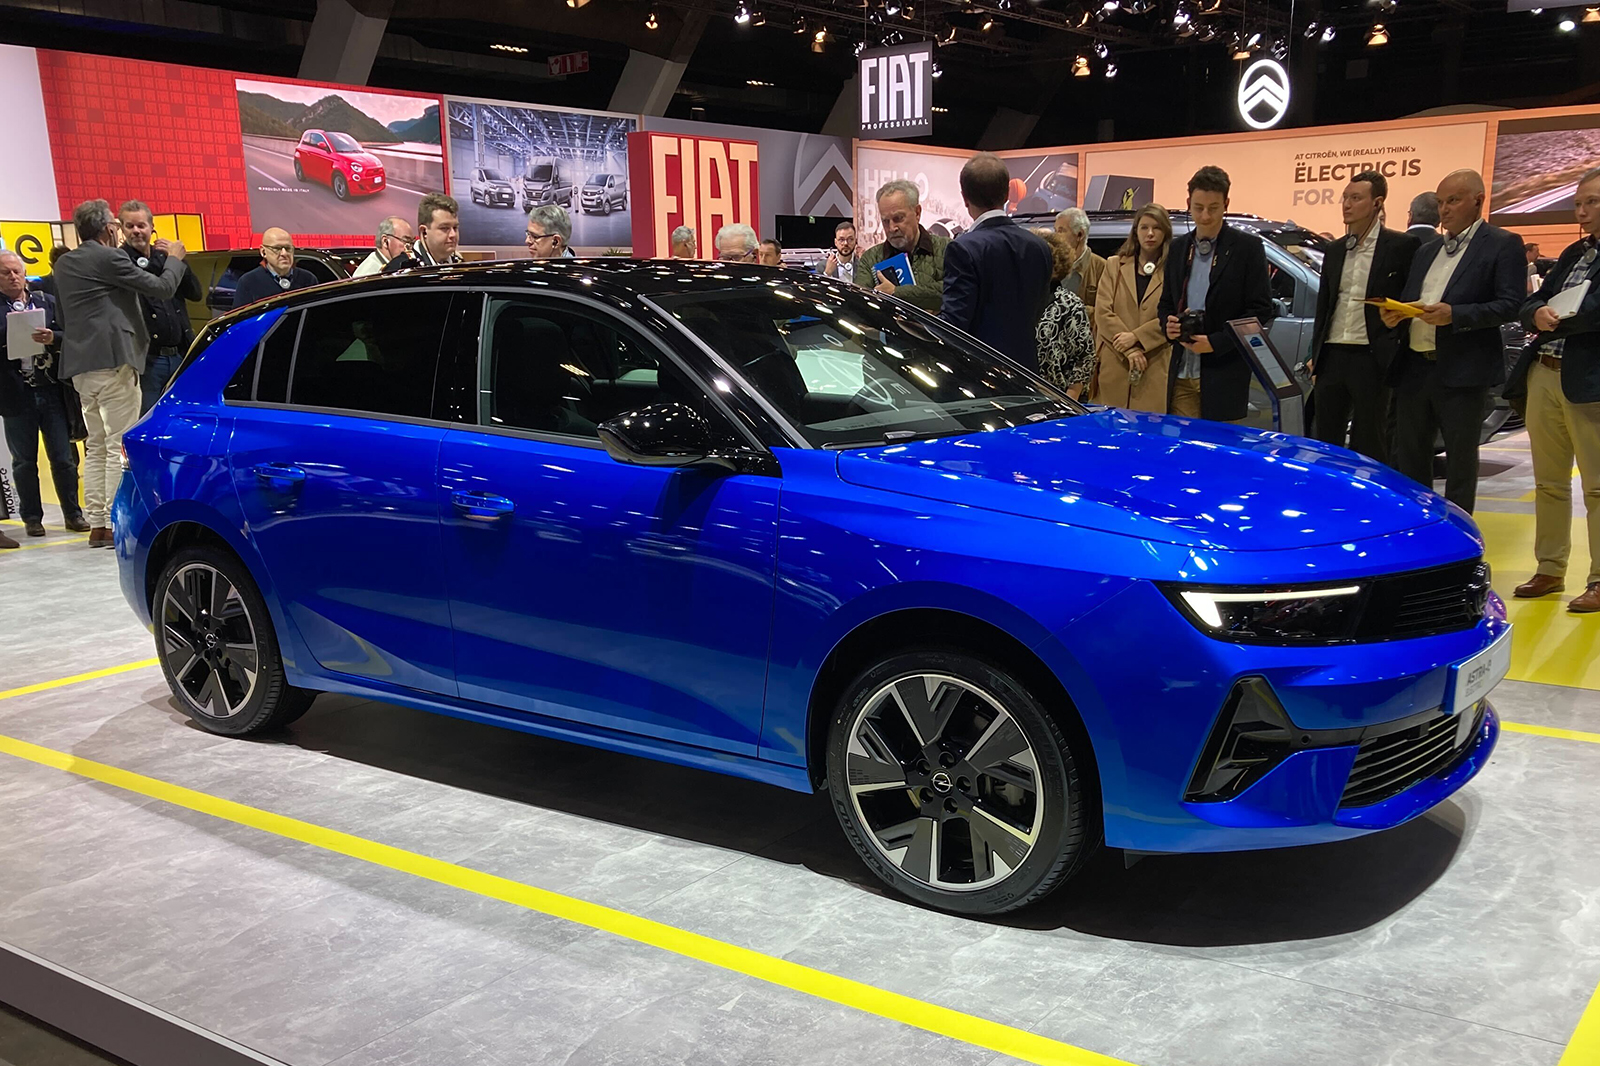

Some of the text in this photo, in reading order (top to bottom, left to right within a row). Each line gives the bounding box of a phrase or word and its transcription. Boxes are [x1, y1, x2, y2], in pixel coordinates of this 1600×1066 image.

[861, 52, 929, 123] FIAT
[861, 119, 928, 130] PROFESSIONAL
[1305, 151, 1339, 160] CITROËN,
[1340, 149, 1352, 157] WE
[1353, 147, 1385, 156] (REALLY)
[1386, 145, 1411, 153] THINK
[1401, 158, 1422, 177] IS
[651, 135, 758, 259] FIAT
[1292, 188, 1335, 206] FOR
